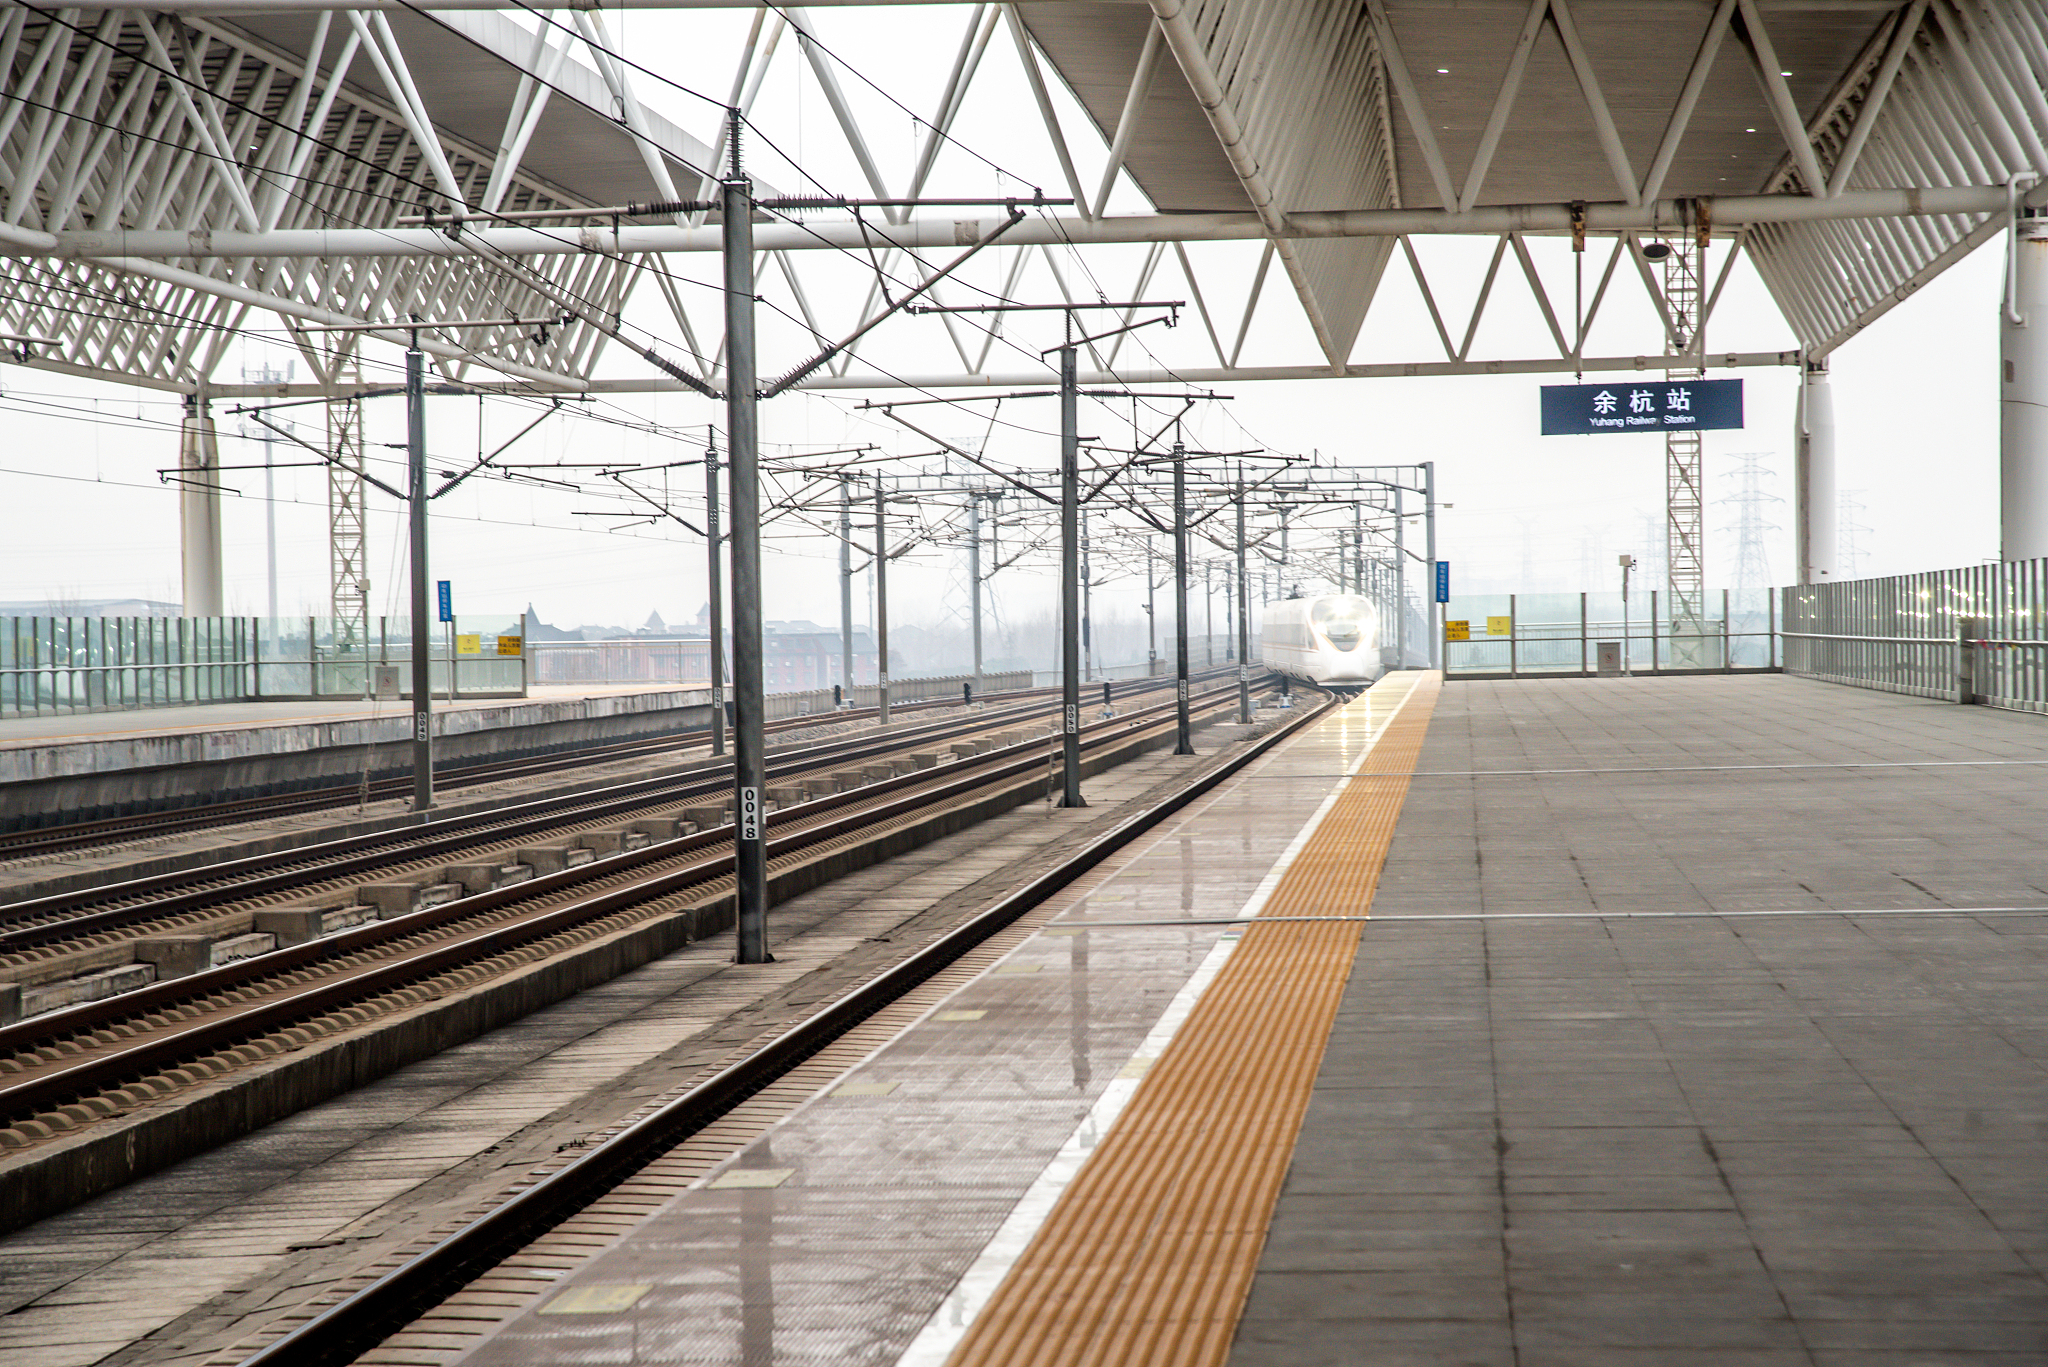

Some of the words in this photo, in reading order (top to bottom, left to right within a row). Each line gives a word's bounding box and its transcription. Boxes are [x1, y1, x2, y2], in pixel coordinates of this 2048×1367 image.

[1593, 387, 1691, 414] 余杭站
[1589, 417, 1624, 428] Yuhang
[1664, 414, 1696, 424] Station
[745, 789, 755, 838] 0048
